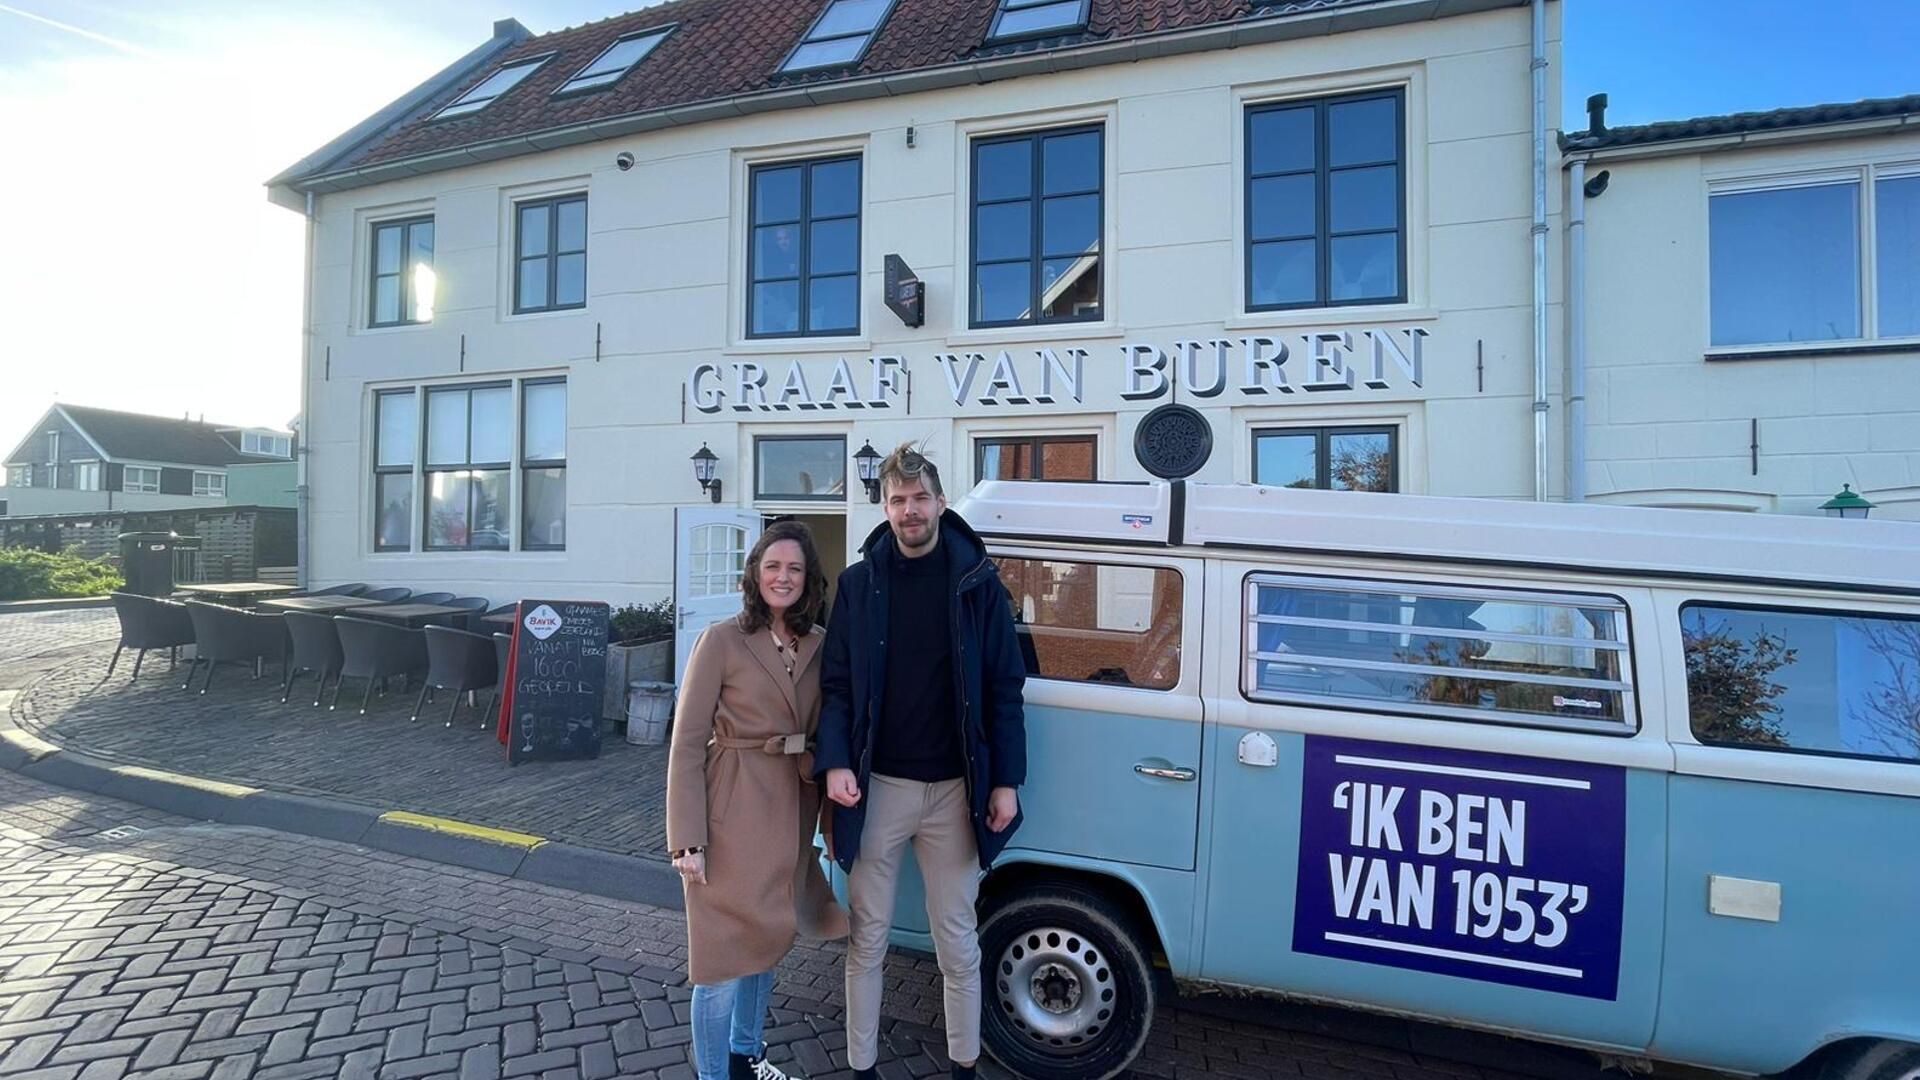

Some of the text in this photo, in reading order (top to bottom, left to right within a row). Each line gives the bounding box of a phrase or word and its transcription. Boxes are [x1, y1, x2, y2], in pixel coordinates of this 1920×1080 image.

[688, 327, 1430, 414] GRAAF VAN BUREN
[529, 616, 557, 625] BAVIK
[1418, 789, 1526, 867] BEN
[1328, 853, 1436, 930] VAN
